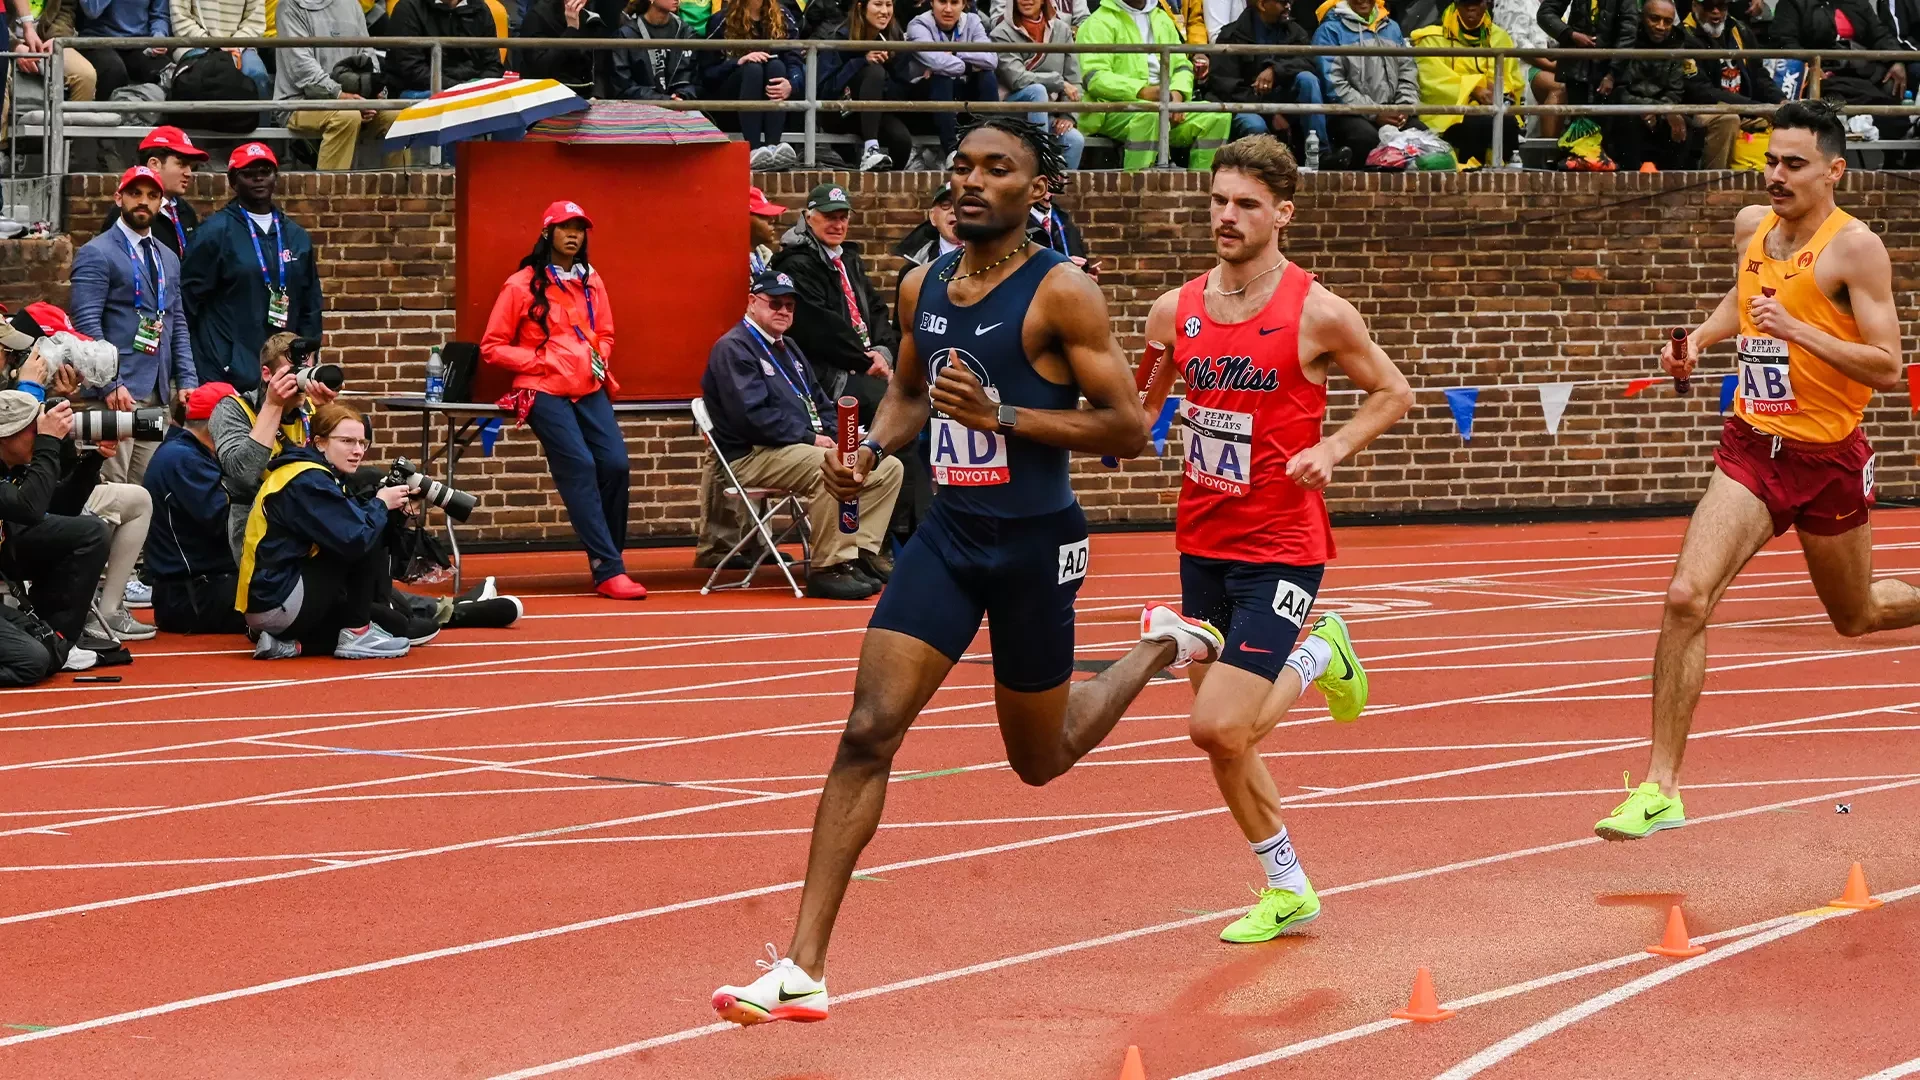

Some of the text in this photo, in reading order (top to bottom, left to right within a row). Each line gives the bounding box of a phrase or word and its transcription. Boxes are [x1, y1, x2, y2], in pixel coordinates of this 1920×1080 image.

[1185, 317, 1201, 337] SEC
[1751, 346, 1781, 354] RELAYS
[1145, 357, 1162, 389] TOYOTA
[1185, 356, 1279, 392] Ole Miss
[1744, 365, 1787, 399] AB
[1204, 410, 1233, 421] PENN
[1754, 402, 1793, 413] TOYOTA
[847, 413, 855, 450] TOYOTA
[1202, 418, 1242, 431] RELAYS
[950, 470, 1001, 482] TOYOTA
[1199, 474, 1242, 495] TOYOTA
[1062, 546, 1087, 578] AD
[1277, 590, 1306, 623] AA
